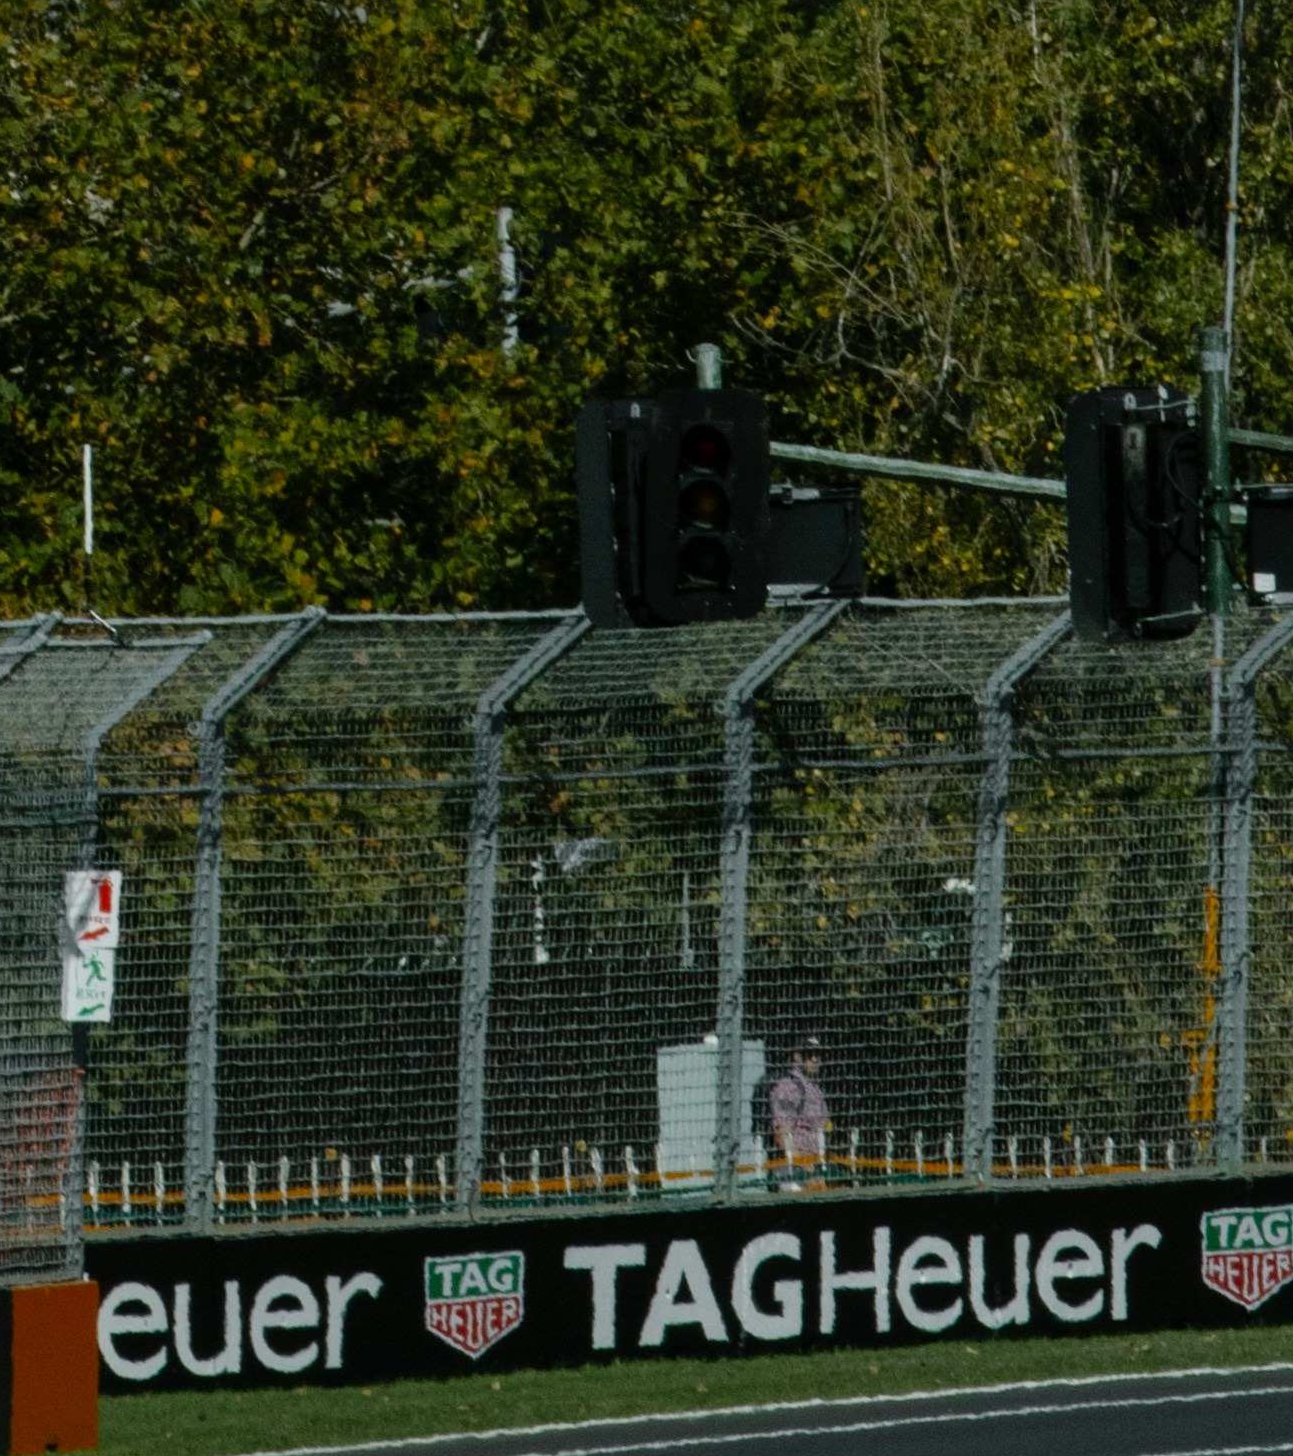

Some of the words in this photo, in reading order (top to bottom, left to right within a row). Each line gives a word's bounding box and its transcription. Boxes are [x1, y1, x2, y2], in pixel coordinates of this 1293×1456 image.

[1210, 1212, 1291, 1249] TAG
[435, 1258, 515, 1297] TAG
[1207, 1251, 1291, 1302] HEUER
[430, 1299, 519, 1350] HEUER
